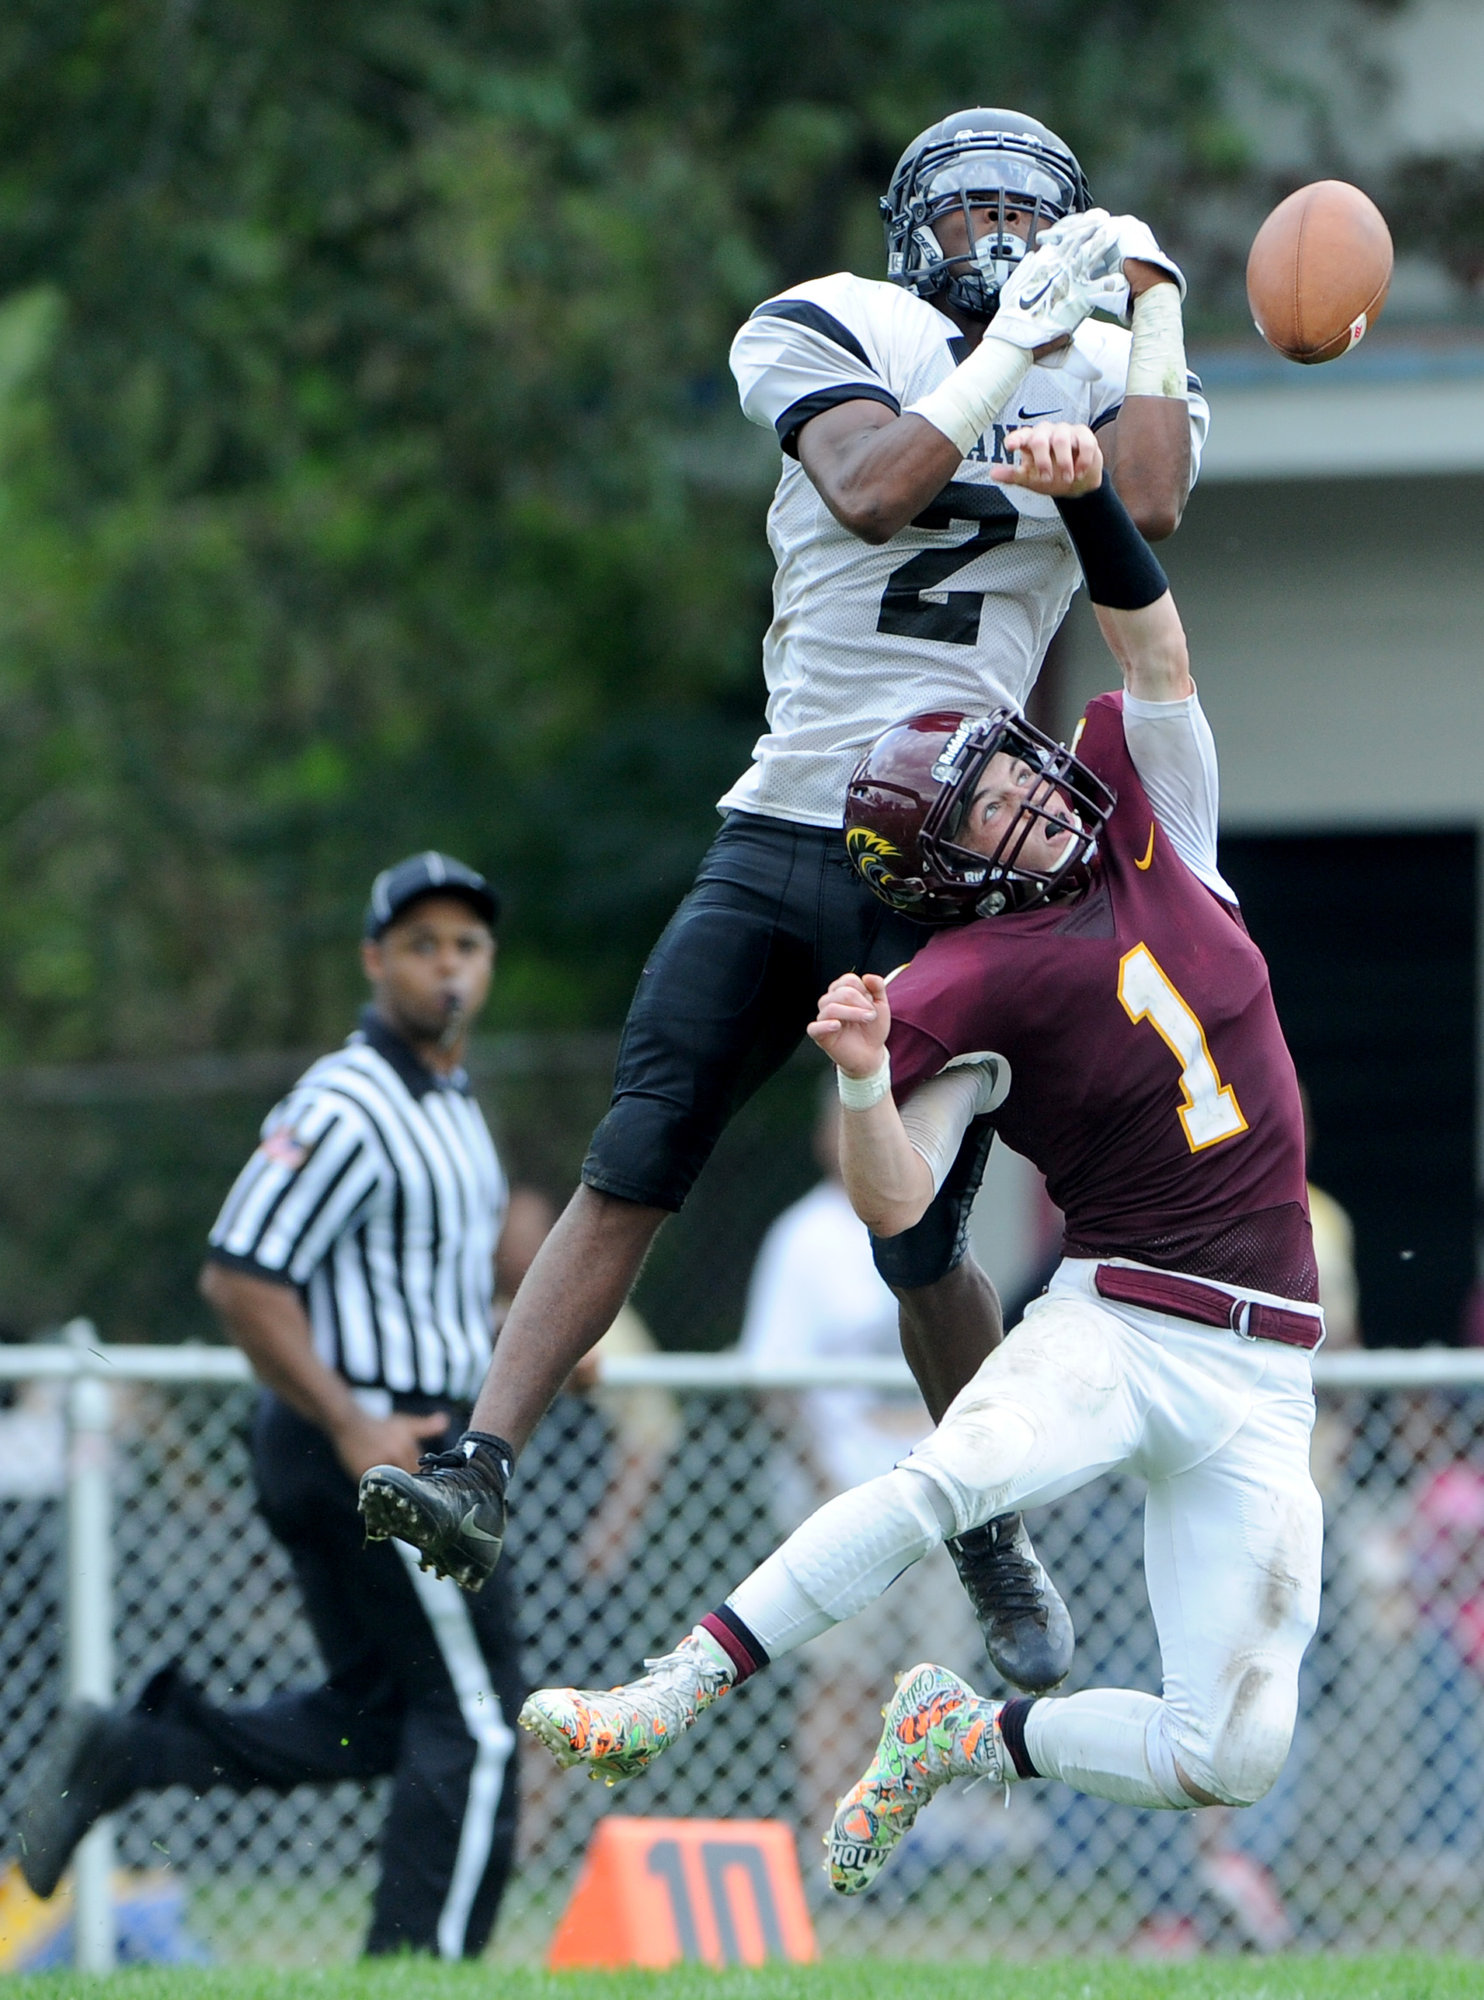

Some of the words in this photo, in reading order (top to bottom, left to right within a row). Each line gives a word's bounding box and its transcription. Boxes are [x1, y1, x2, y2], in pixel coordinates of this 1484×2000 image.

[876, 481, 1019, 646] 2
[1117, 941, 1249, 1154] 1
[647, 1838, 787, 1967] 10
